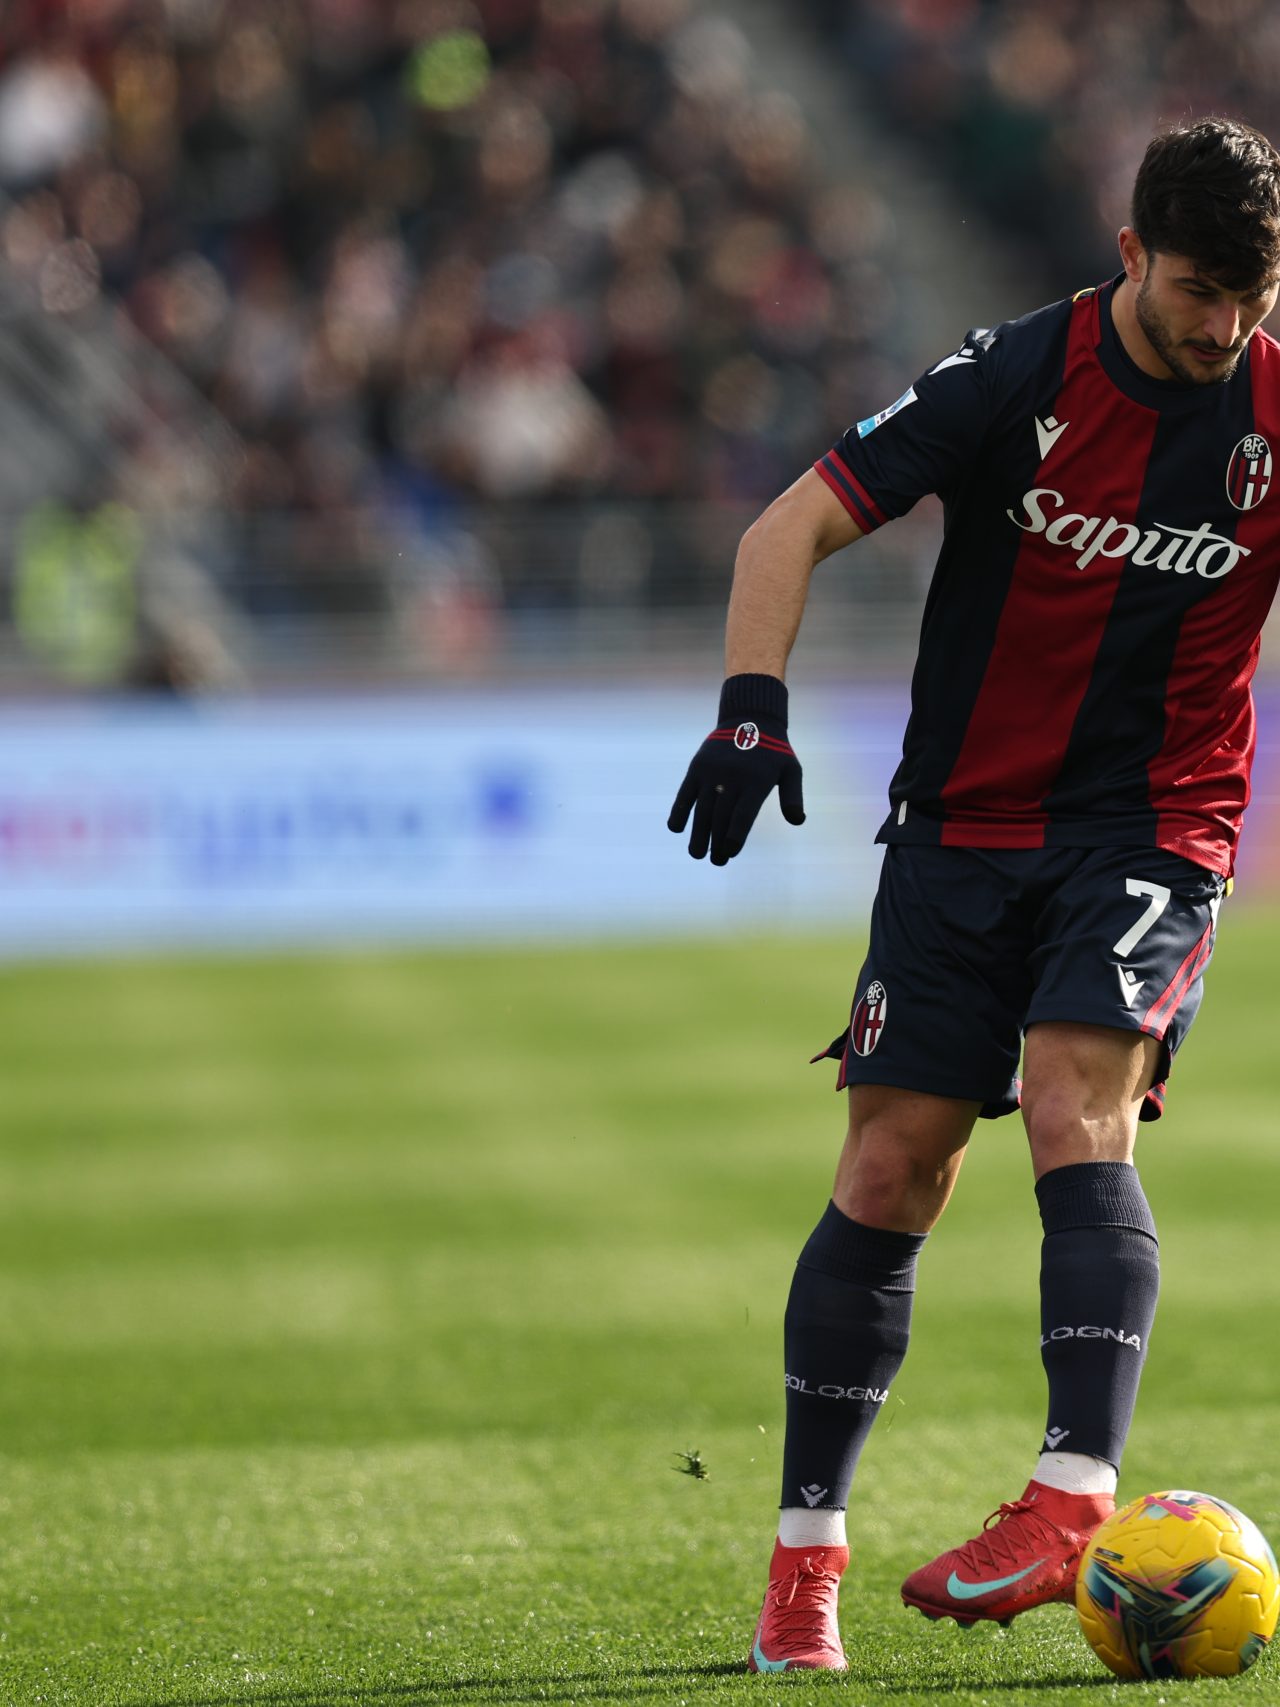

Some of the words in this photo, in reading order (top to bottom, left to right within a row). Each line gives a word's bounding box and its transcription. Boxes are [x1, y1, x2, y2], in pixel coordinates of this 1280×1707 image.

[1243, 437, 1264, 453] BFC
[1006, 488, 1252, 579] Saputo
[1112, 877, 1171, 958] 7
[867, 984, 882, 999] BFC
